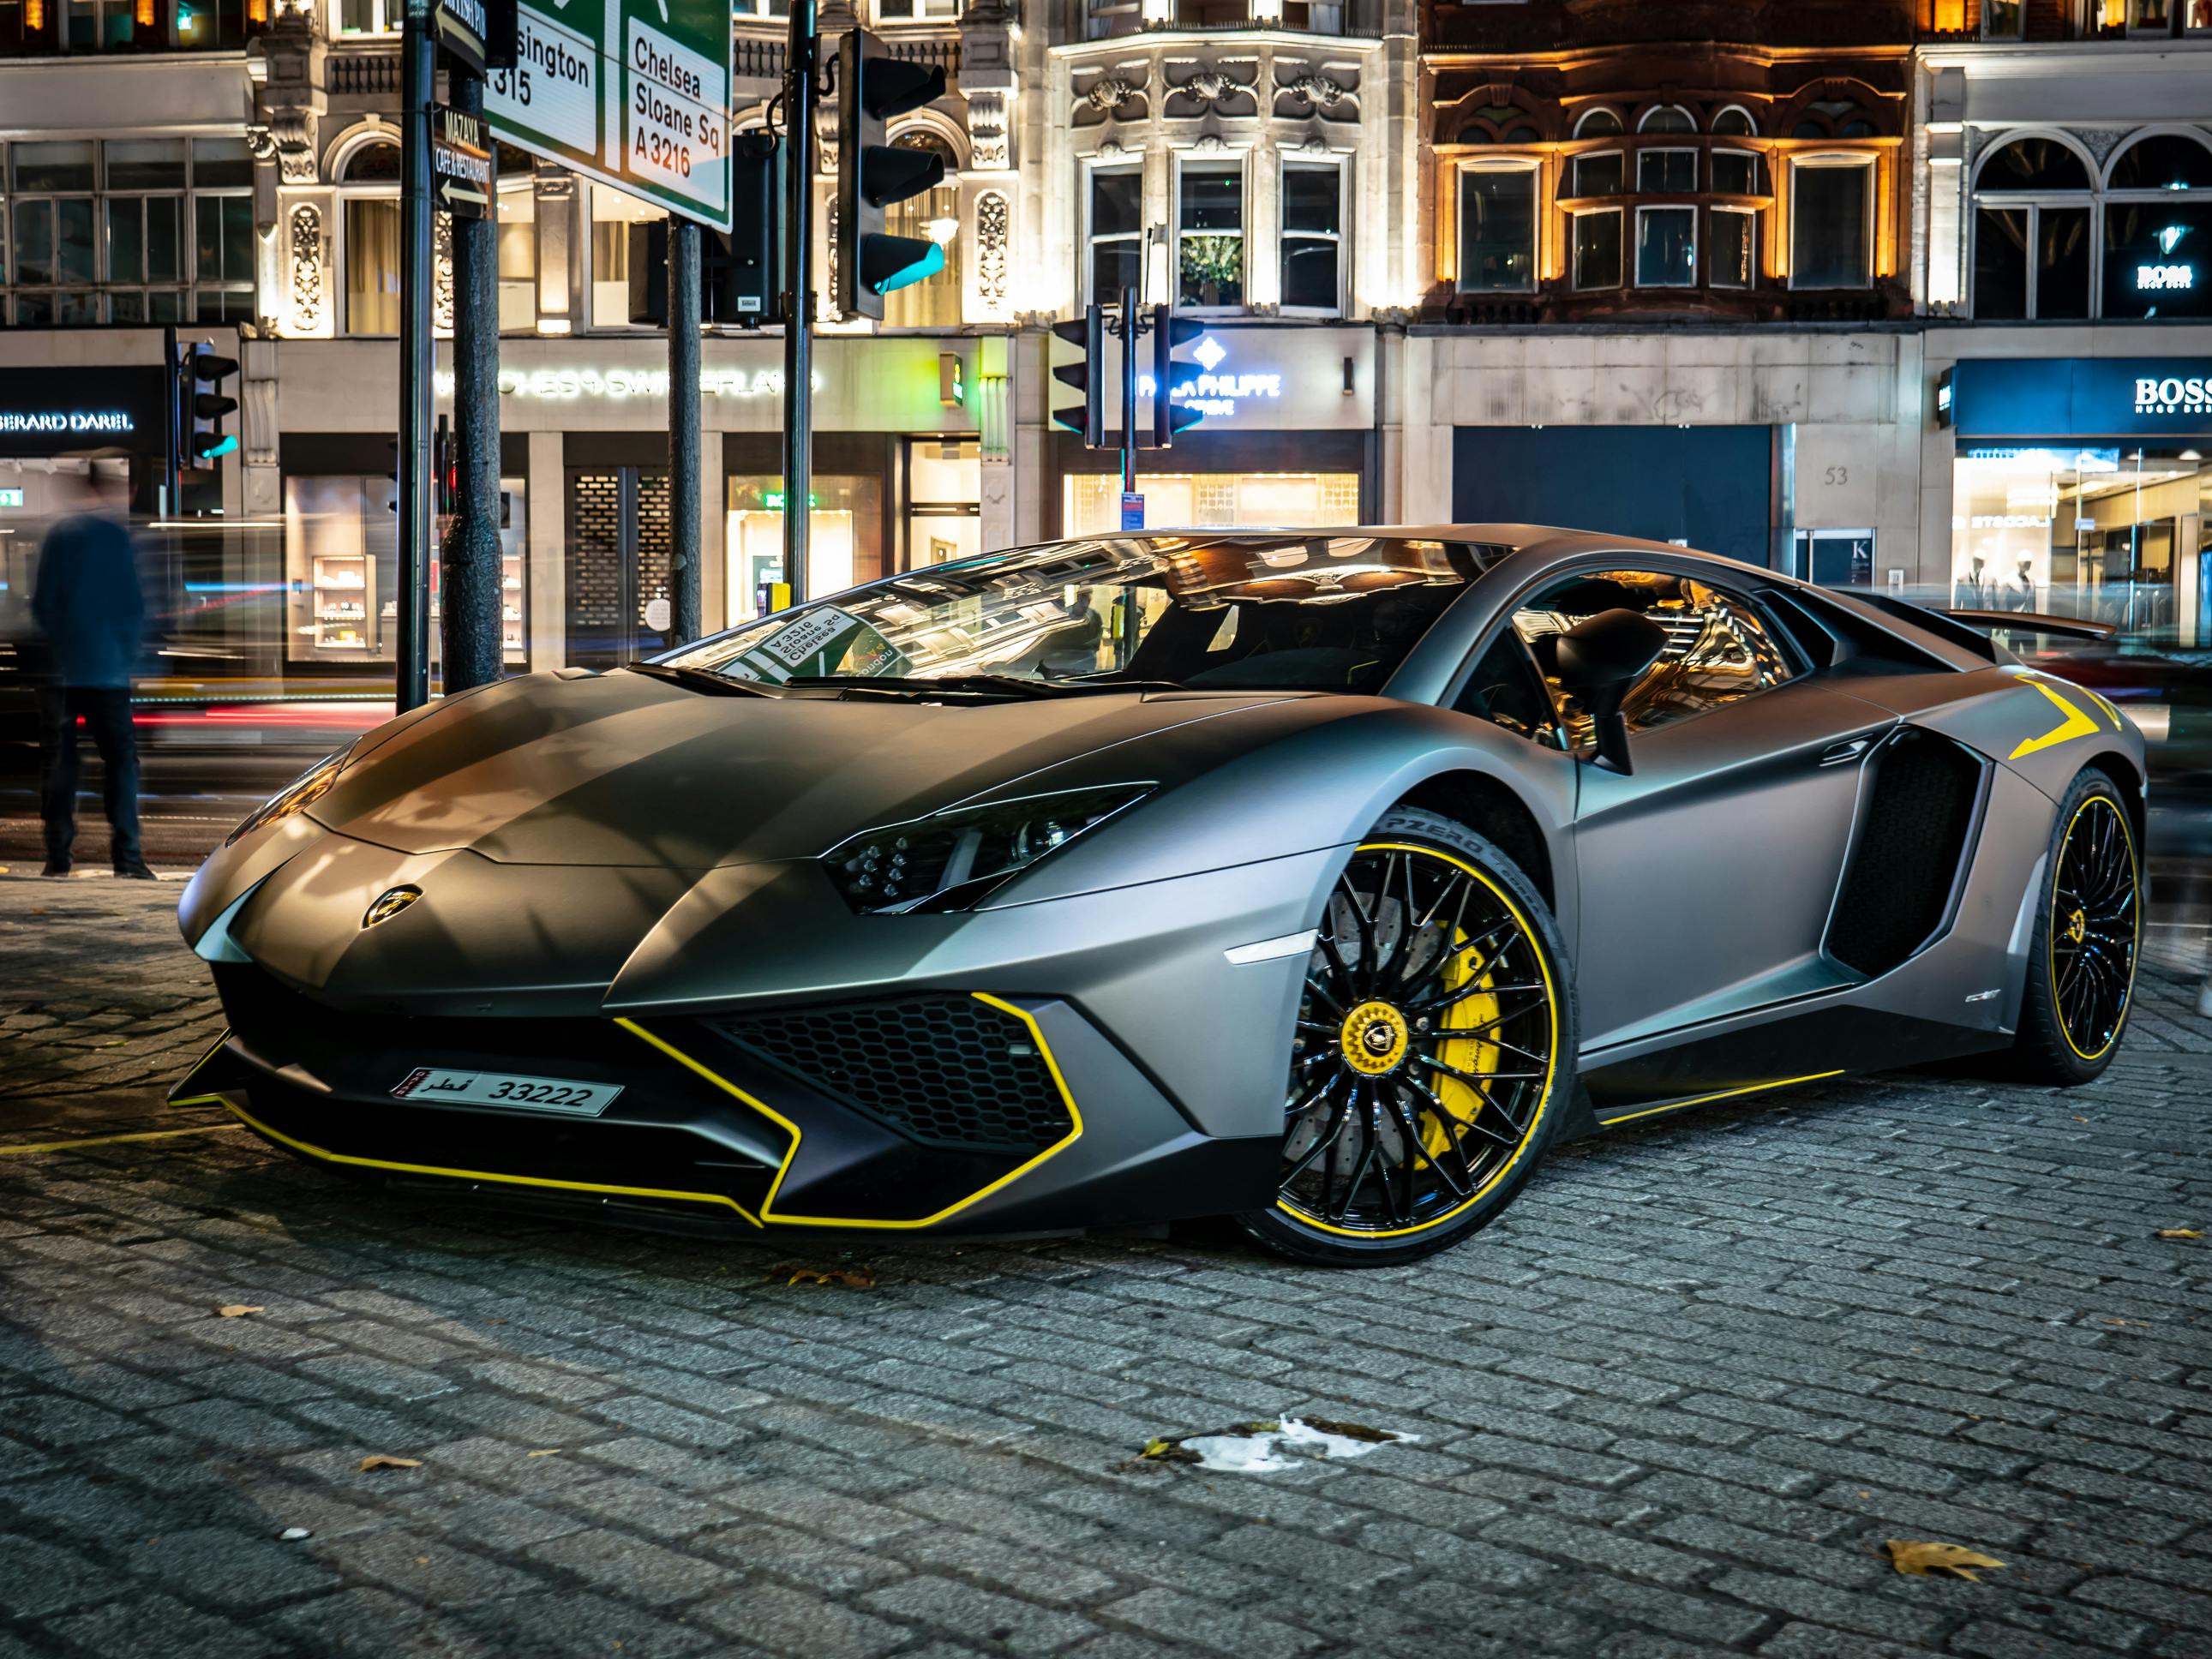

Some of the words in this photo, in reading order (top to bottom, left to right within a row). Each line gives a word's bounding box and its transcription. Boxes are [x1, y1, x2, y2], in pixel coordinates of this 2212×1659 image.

[518, 25, 589, 88] sington
[635, 37, 701, 99] Chelsea
[446, 110, 479, 152] MAZAYA
[636, 82, 692, 138] Sloane
[698, 114, 719, 158] Sq
[1824, 466, 1848, 486] 53
[1851, 540, 1869, 559] K
[420, 1077, 474, 1093] قطر
[488, 1081, 593, 1107] 33222
